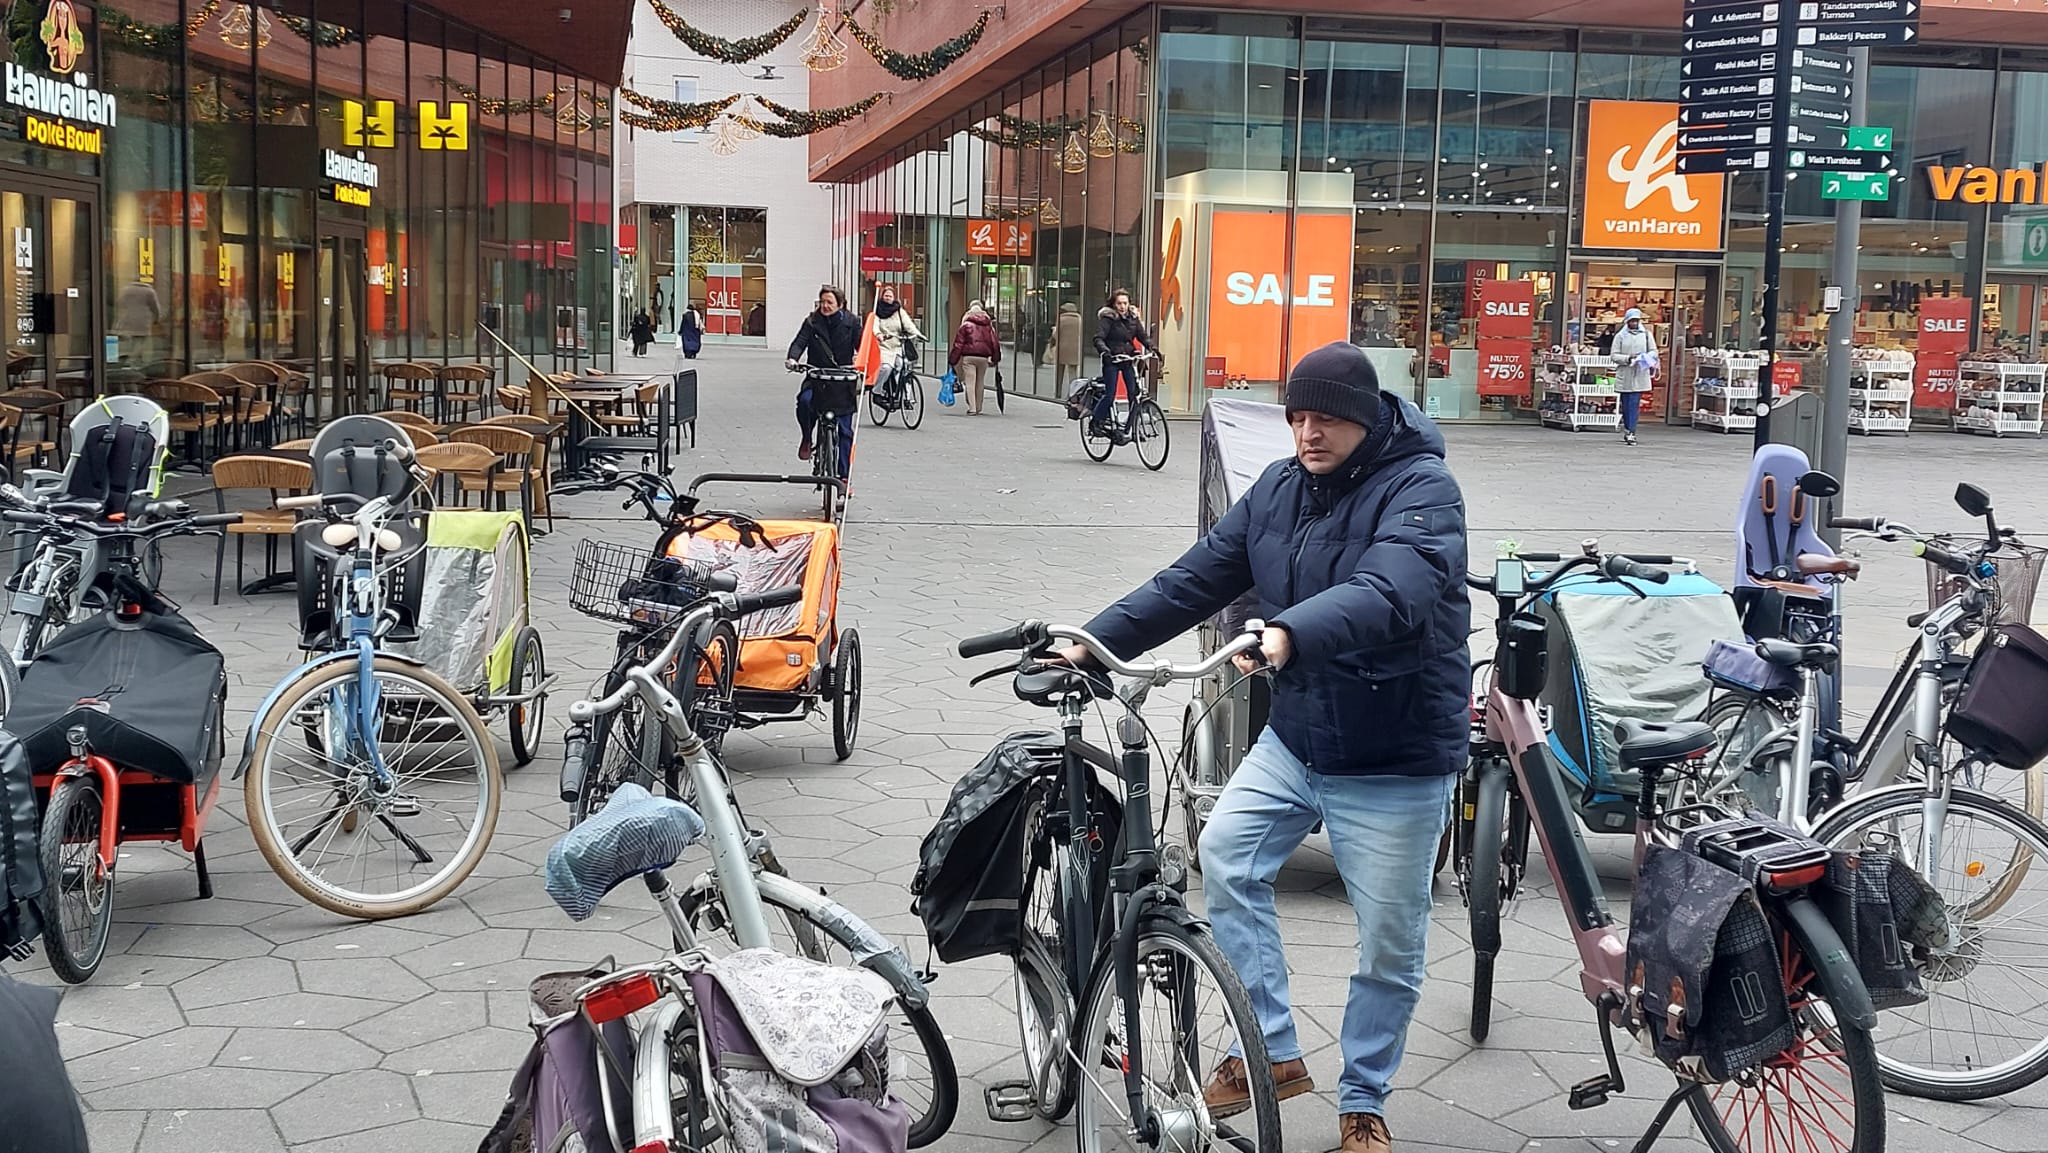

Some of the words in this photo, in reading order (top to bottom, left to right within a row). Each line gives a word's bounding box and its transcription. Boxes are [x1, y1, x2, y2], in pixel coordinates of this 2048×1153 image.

[1725, 11, 1762, 21] Adventure
[1821, 11, 1855, 19] Turnova
[1737, 34, 1760, 44] Hotels
[1819, 32, 1854, 41] Bakkerij
[1855, 31, 1887, 40] Peeters
[5, 61, 117, 128] Hawaiian
[1730, 84, 1757, 93] Fashion
[1701, 110, 1729, 120] Fashion
[1729, 109, 1756, 119] Factory
[1807, 155, 1826, 164] Visit
[1826, 156, 1862, 166] Turnhout
[325, 147, 379, 189] Hawaiian
[1928, 161, 2048, 205] van
[1604, 217, 1702, 236] vanHaren
[1225, 271, 1336, 307] SALE
[708, 290, 740, 309] SALE
[1484, 301, 1531, 317] SALE
[1923, 318, 1968, 333] SALE
[1489, 355, 1503, 363] NU
[1503, 355, 1521, 363] TOT
[1483, 363, 1525, 381] -75%
[1928, 369, 1941, 377] NU
